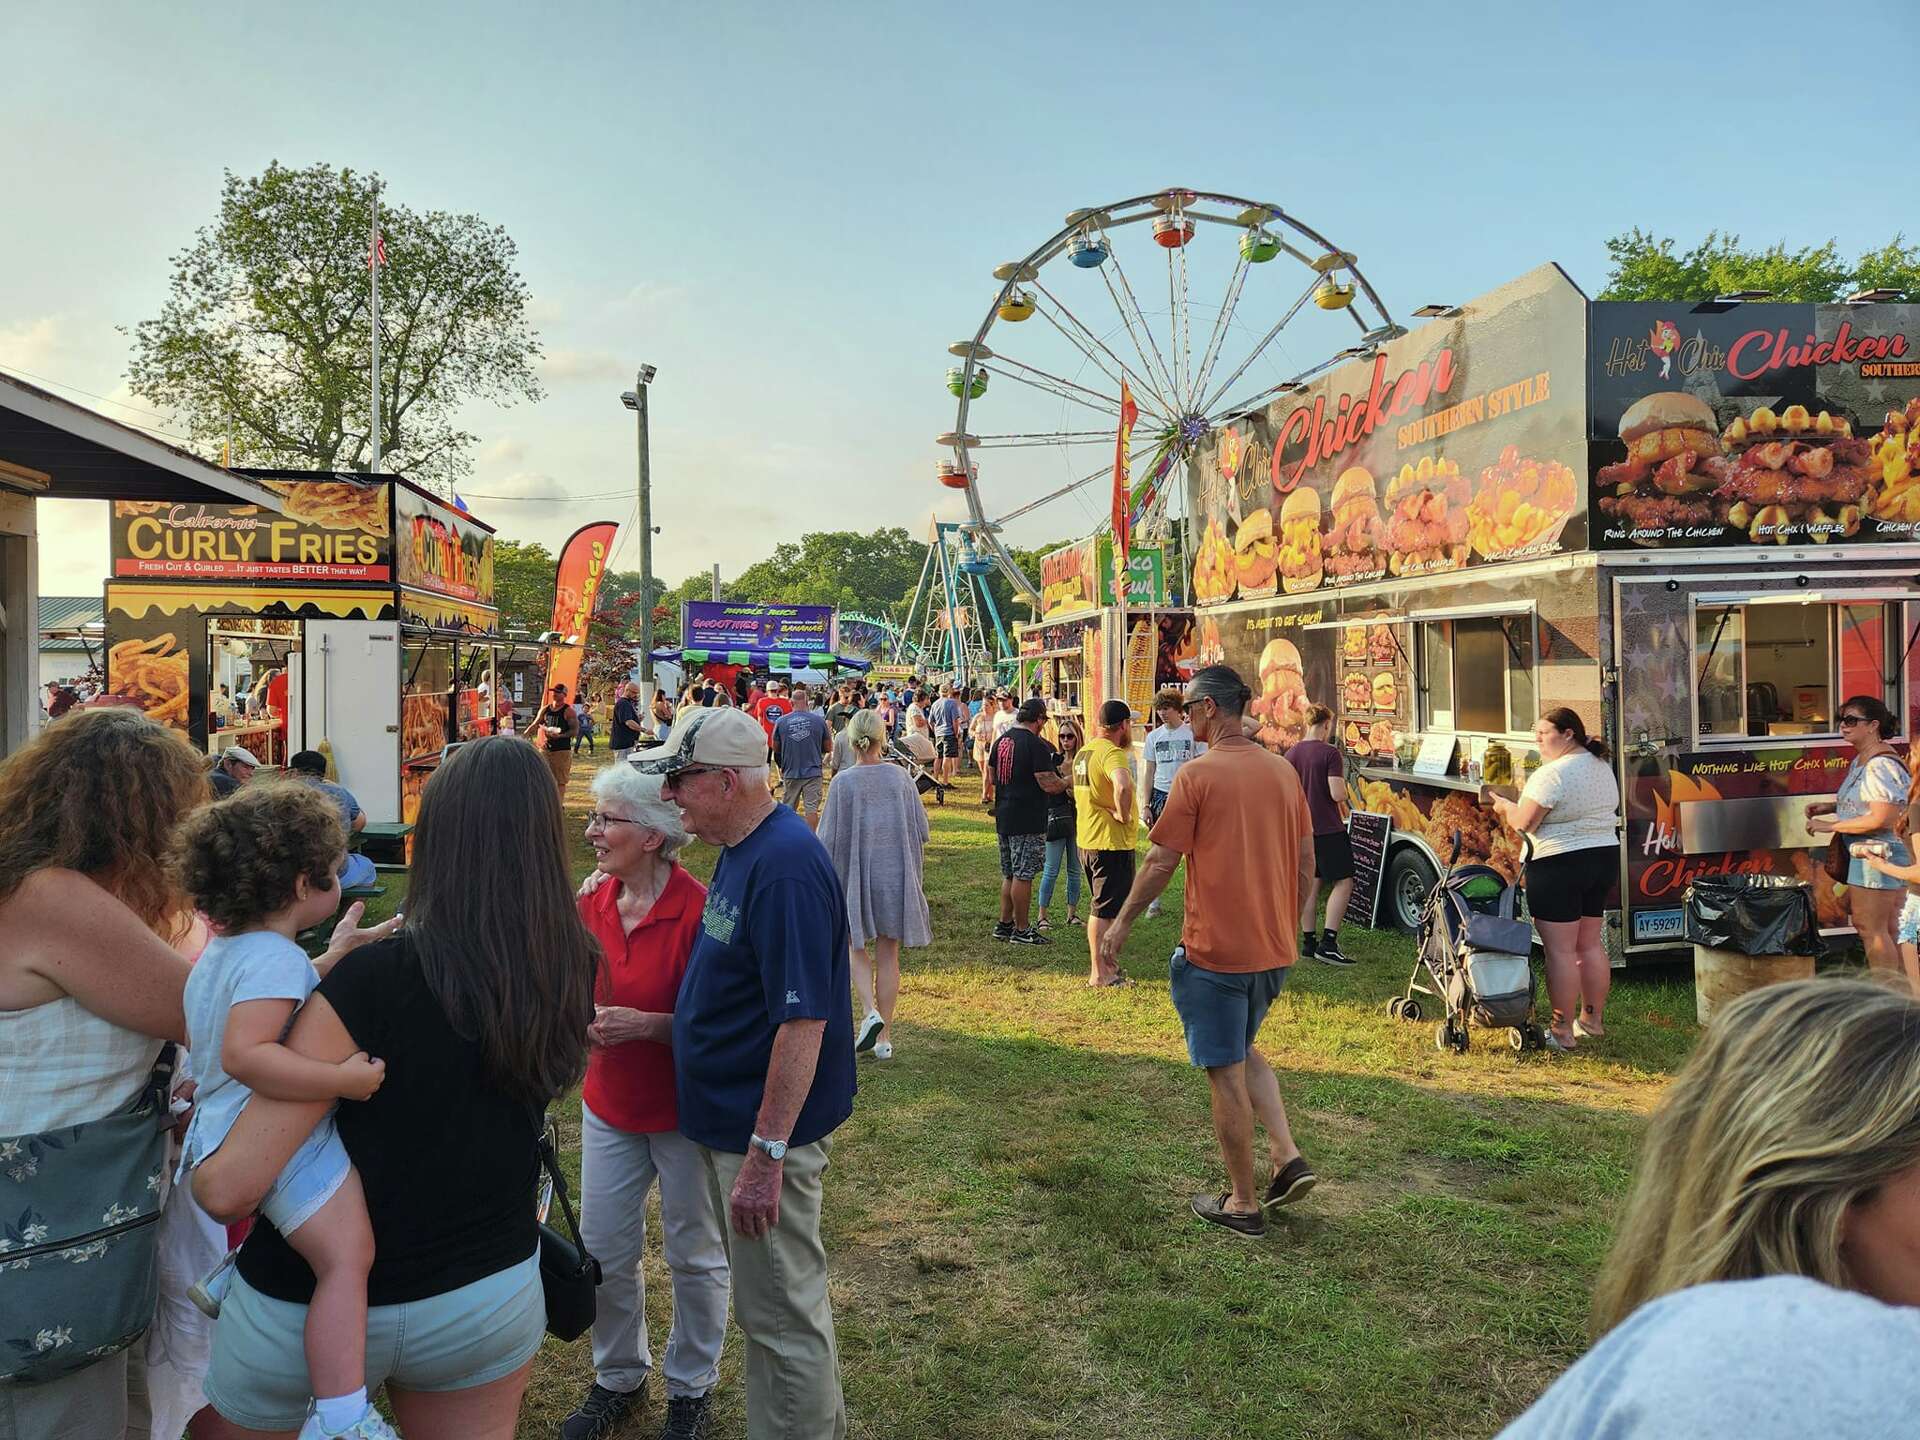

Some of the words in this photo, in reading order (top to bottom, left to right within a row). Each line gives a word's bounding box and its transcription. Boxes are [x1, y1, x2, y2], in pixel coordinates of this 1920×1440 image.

[1605, 337, 1651, 377] Hot
[1678, 338, 1726, 377] Chix
[1726, 321, 1911, 381] Chicken
[1271, 349, 1457, 494] Chicken
[1398, 395, 1485, 450] SOUTHERN
[1488, 371, 1552, 421] STYLE
[164, 504, 258, 531] California
[1806, 522, 1845, 534] WAFFLES
[184, 562, 192, 572] &
[292, 564, 329, 574] BETTER
[574, 540, 604, 630] CURLY
[1692, 762, 1739, 775] NOTHING
[1743, 761, 1767, 773] LIKE
[1769, 760, 1792, 771] HOT
[1794, 758, 1820, 770] CHIX
[1823, 757, 1850, 769] WITH
[1639, 916, 1681, 932] AY-59297
